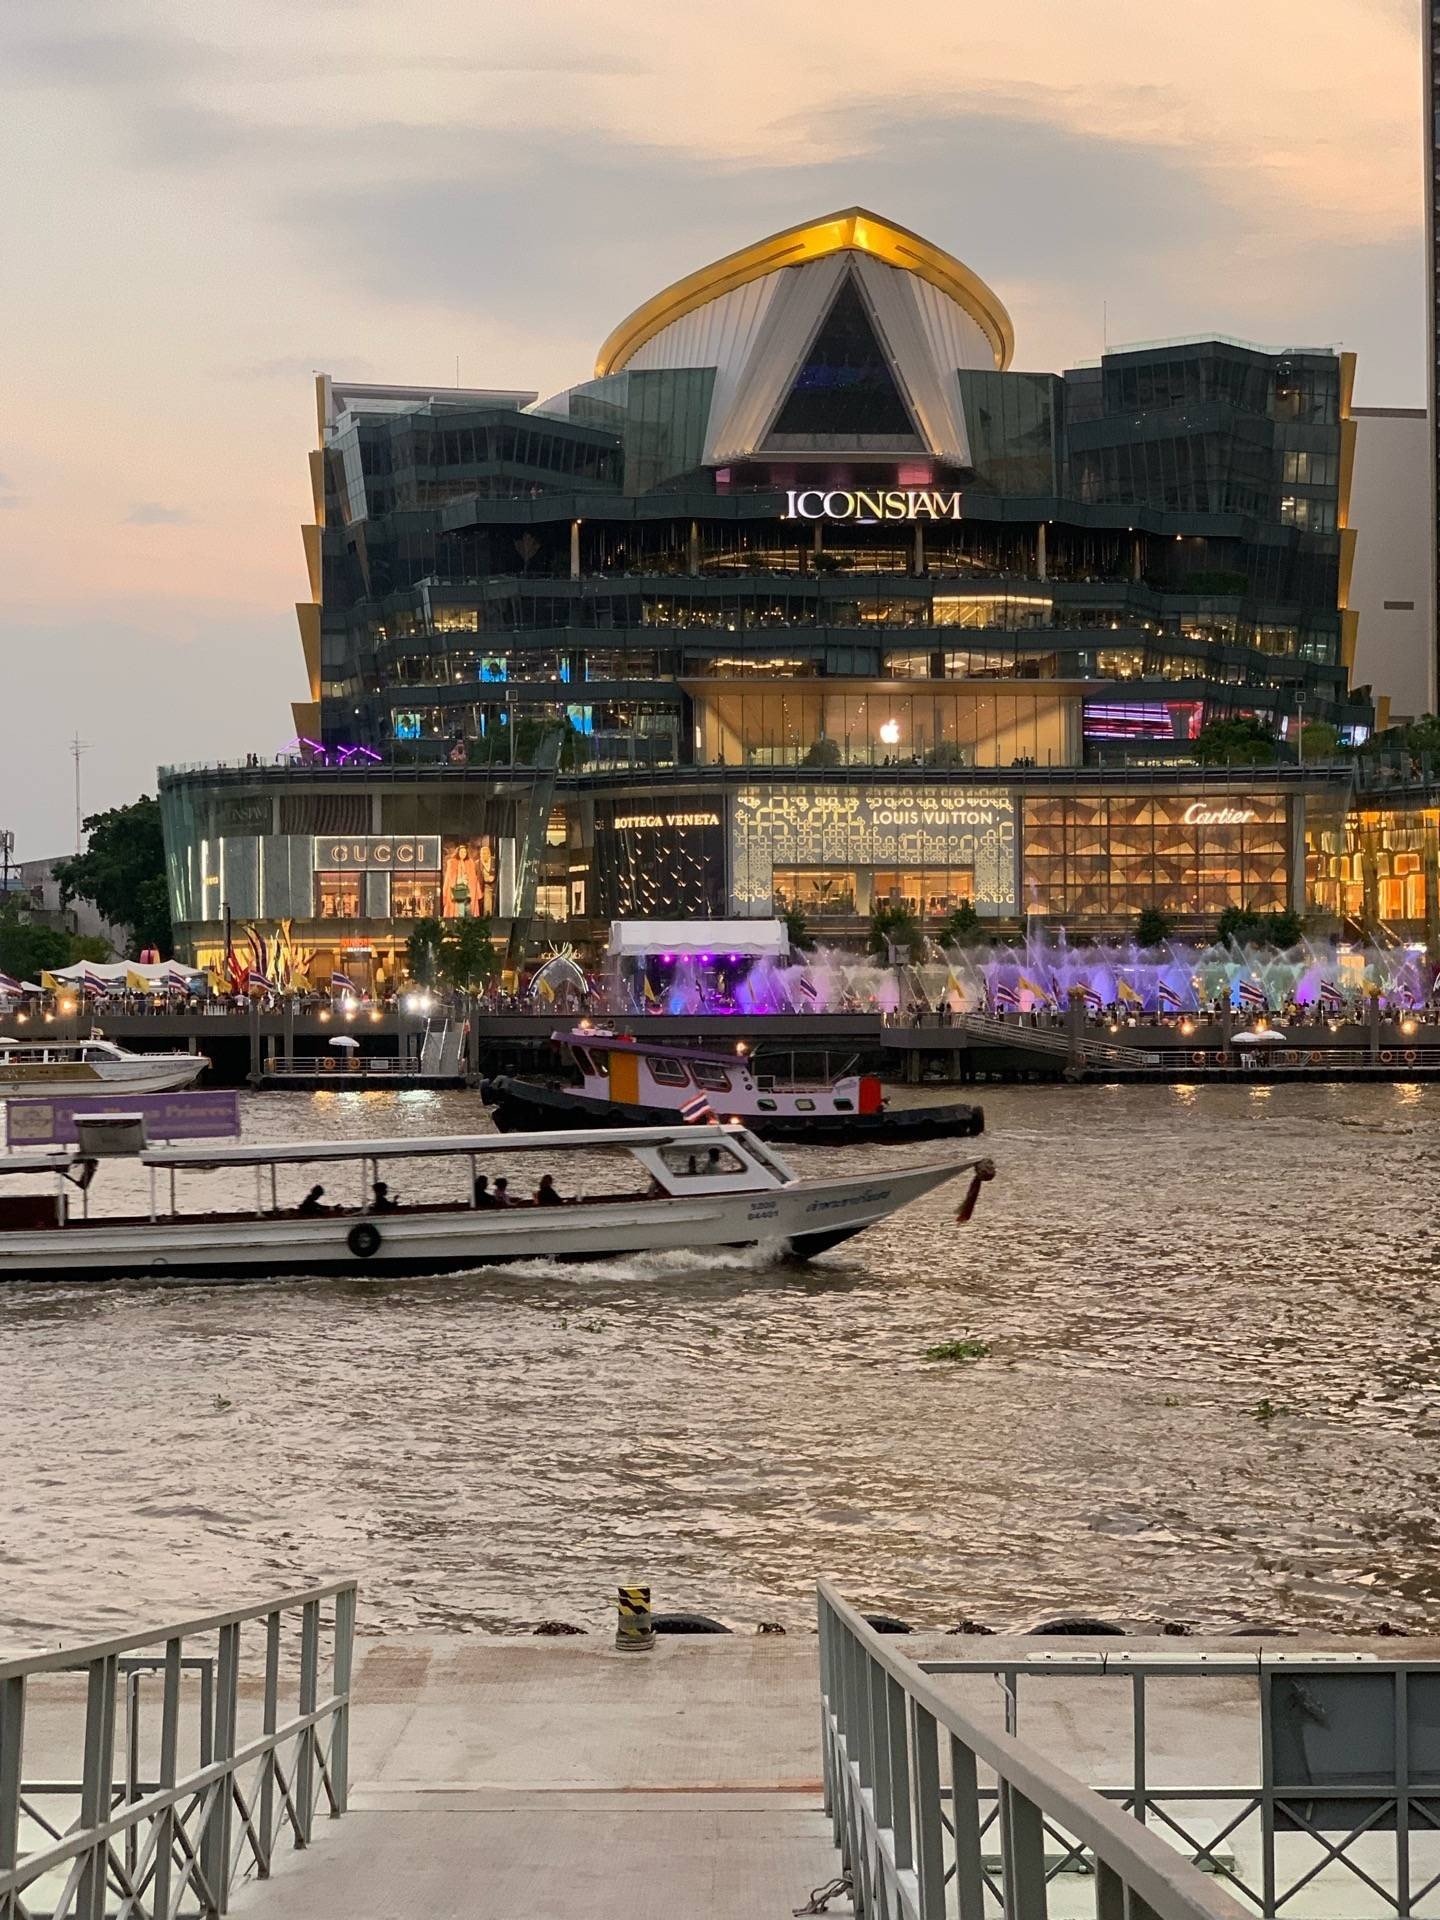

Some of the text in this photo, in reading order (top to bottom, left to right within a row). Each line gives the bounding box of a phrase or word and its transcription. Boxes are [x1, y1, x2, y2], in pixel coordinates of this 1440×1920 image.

[780, 490, 963, 520] ICONSIAM
[614, 816, 664, 829] BOTTEGA
[666, 814, 719, 826] VENETA
[872, 811, 994, 825] LOUIS VUITTON
[1184, 803, 1255, 825] Cartier
[331, 844, 425, 863] GUCCI
